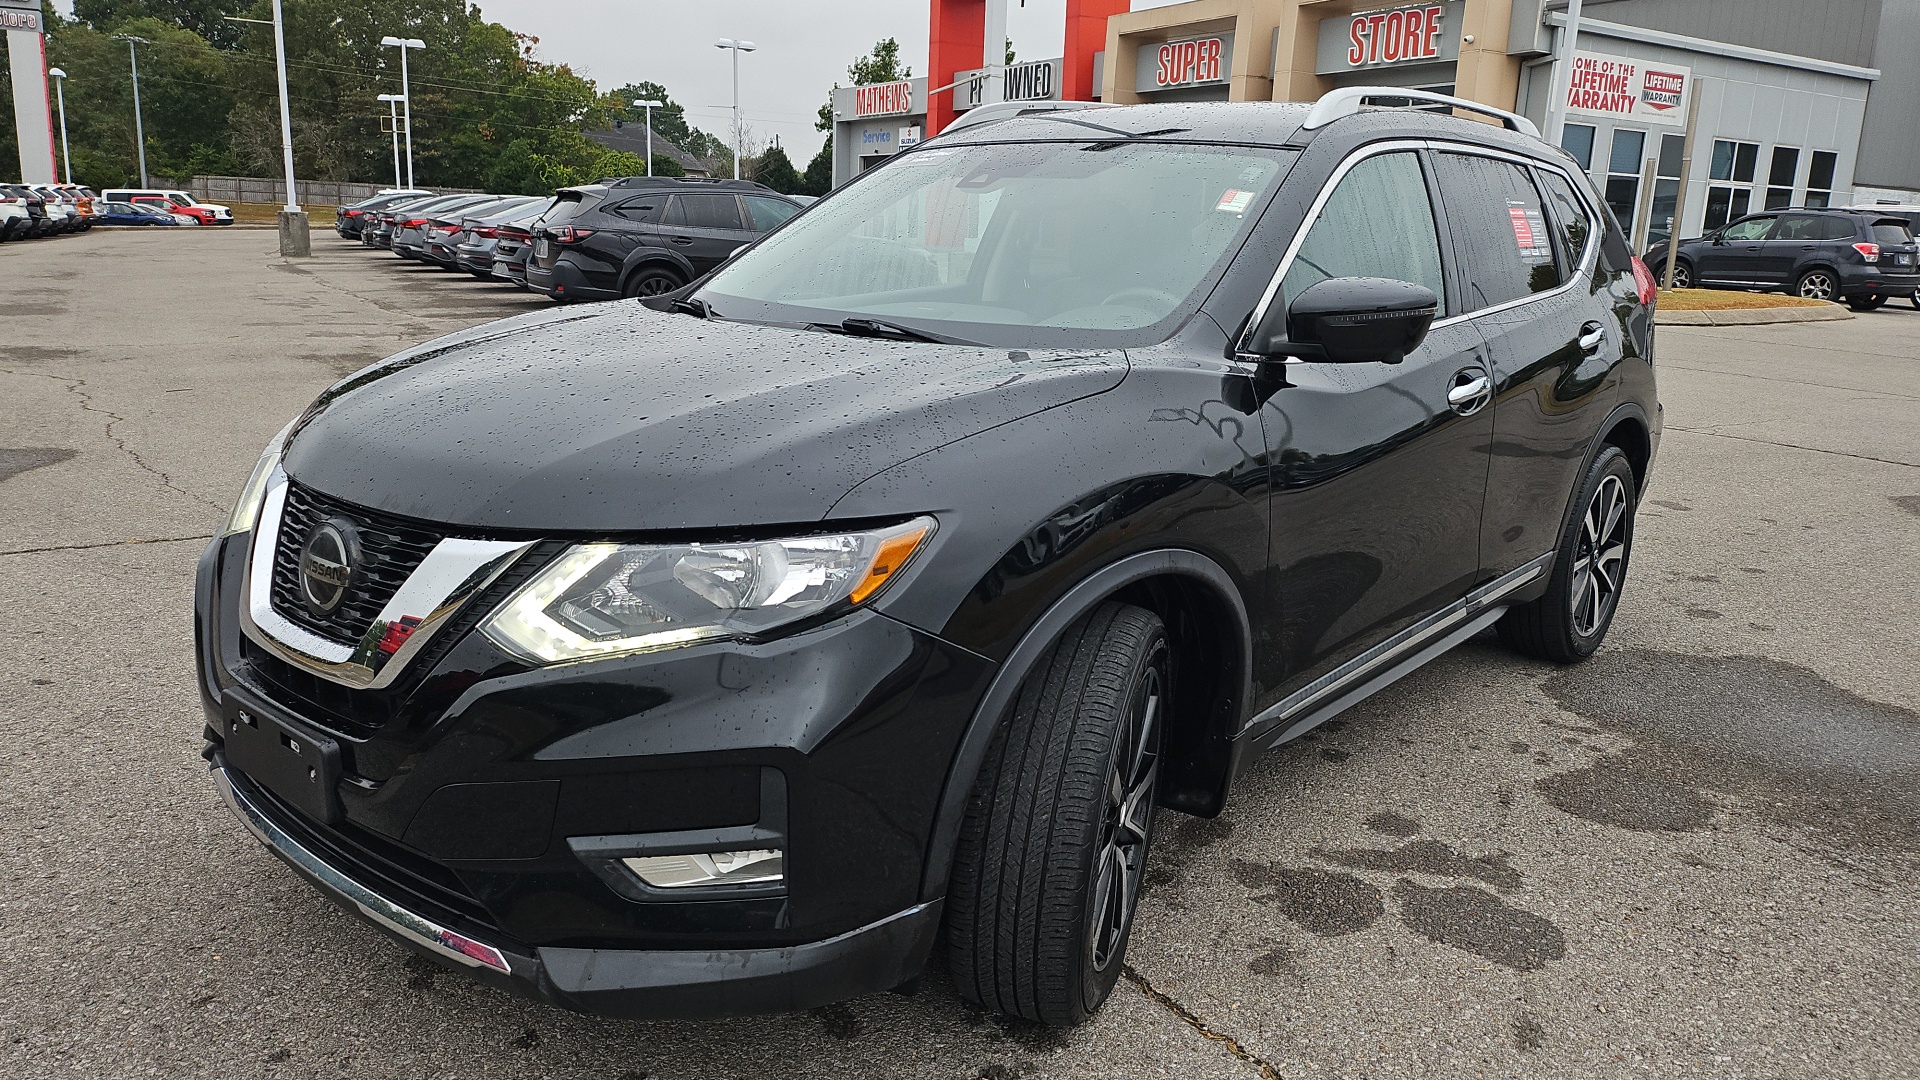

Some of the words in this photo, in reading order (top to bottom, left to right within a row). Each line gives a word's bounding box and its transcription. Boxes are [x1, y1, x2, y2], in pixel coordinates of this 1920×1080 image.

[0, 10, 37, 28] tore
[1349, 6, 1442, 66] STORE
[1157, 38, 1222, 86] SUPER
[1572, 56, 1598, 71] OME
[1601, 61, 1615, 74] OF
[1618, 63, 1636, 76] THE
[1571, 69, 1629, 94] LIFETIME
[1645, 73, 1683, 92] LIFETIME
[856, 82, 910, 116] MATHEWS
[1643, 91, 1681, 106] WARRANTY
[863, 129, 891, 143] Service
[900, 137, 918, 145] SUZUKI
[305, 557, 343, 582] NISSAN
